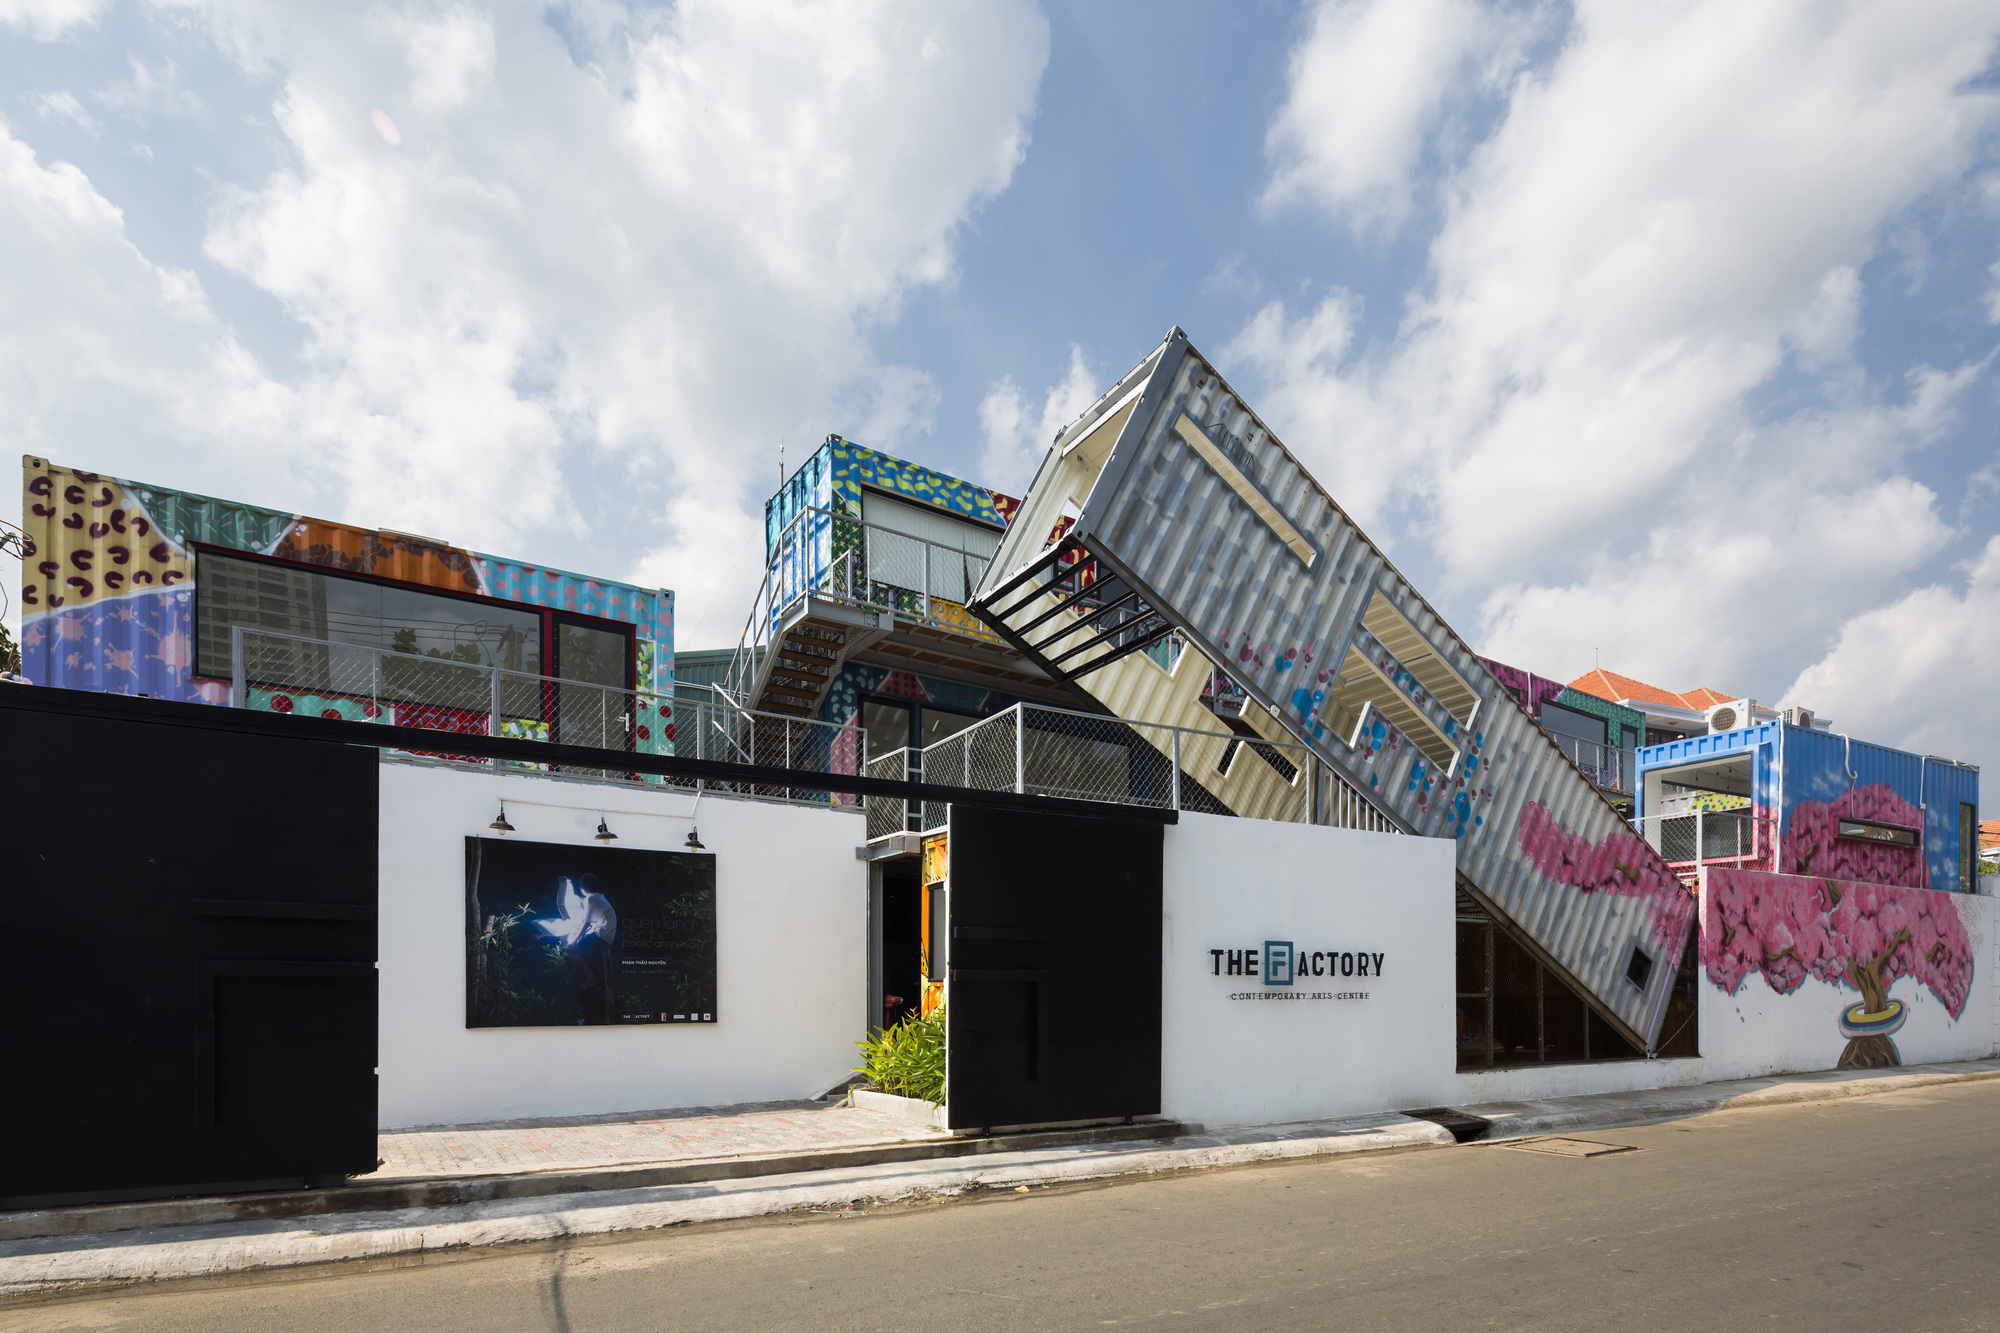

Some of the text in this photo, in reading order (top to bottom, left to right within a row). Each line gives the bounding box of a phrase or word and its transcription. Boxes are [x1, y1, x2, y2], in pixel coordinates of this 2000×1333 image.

[1210, 941, 1385, 985] THE FACTORY
[1231, 992, 1370, 1000] CONTEMPORARY ARTS CENTRE
